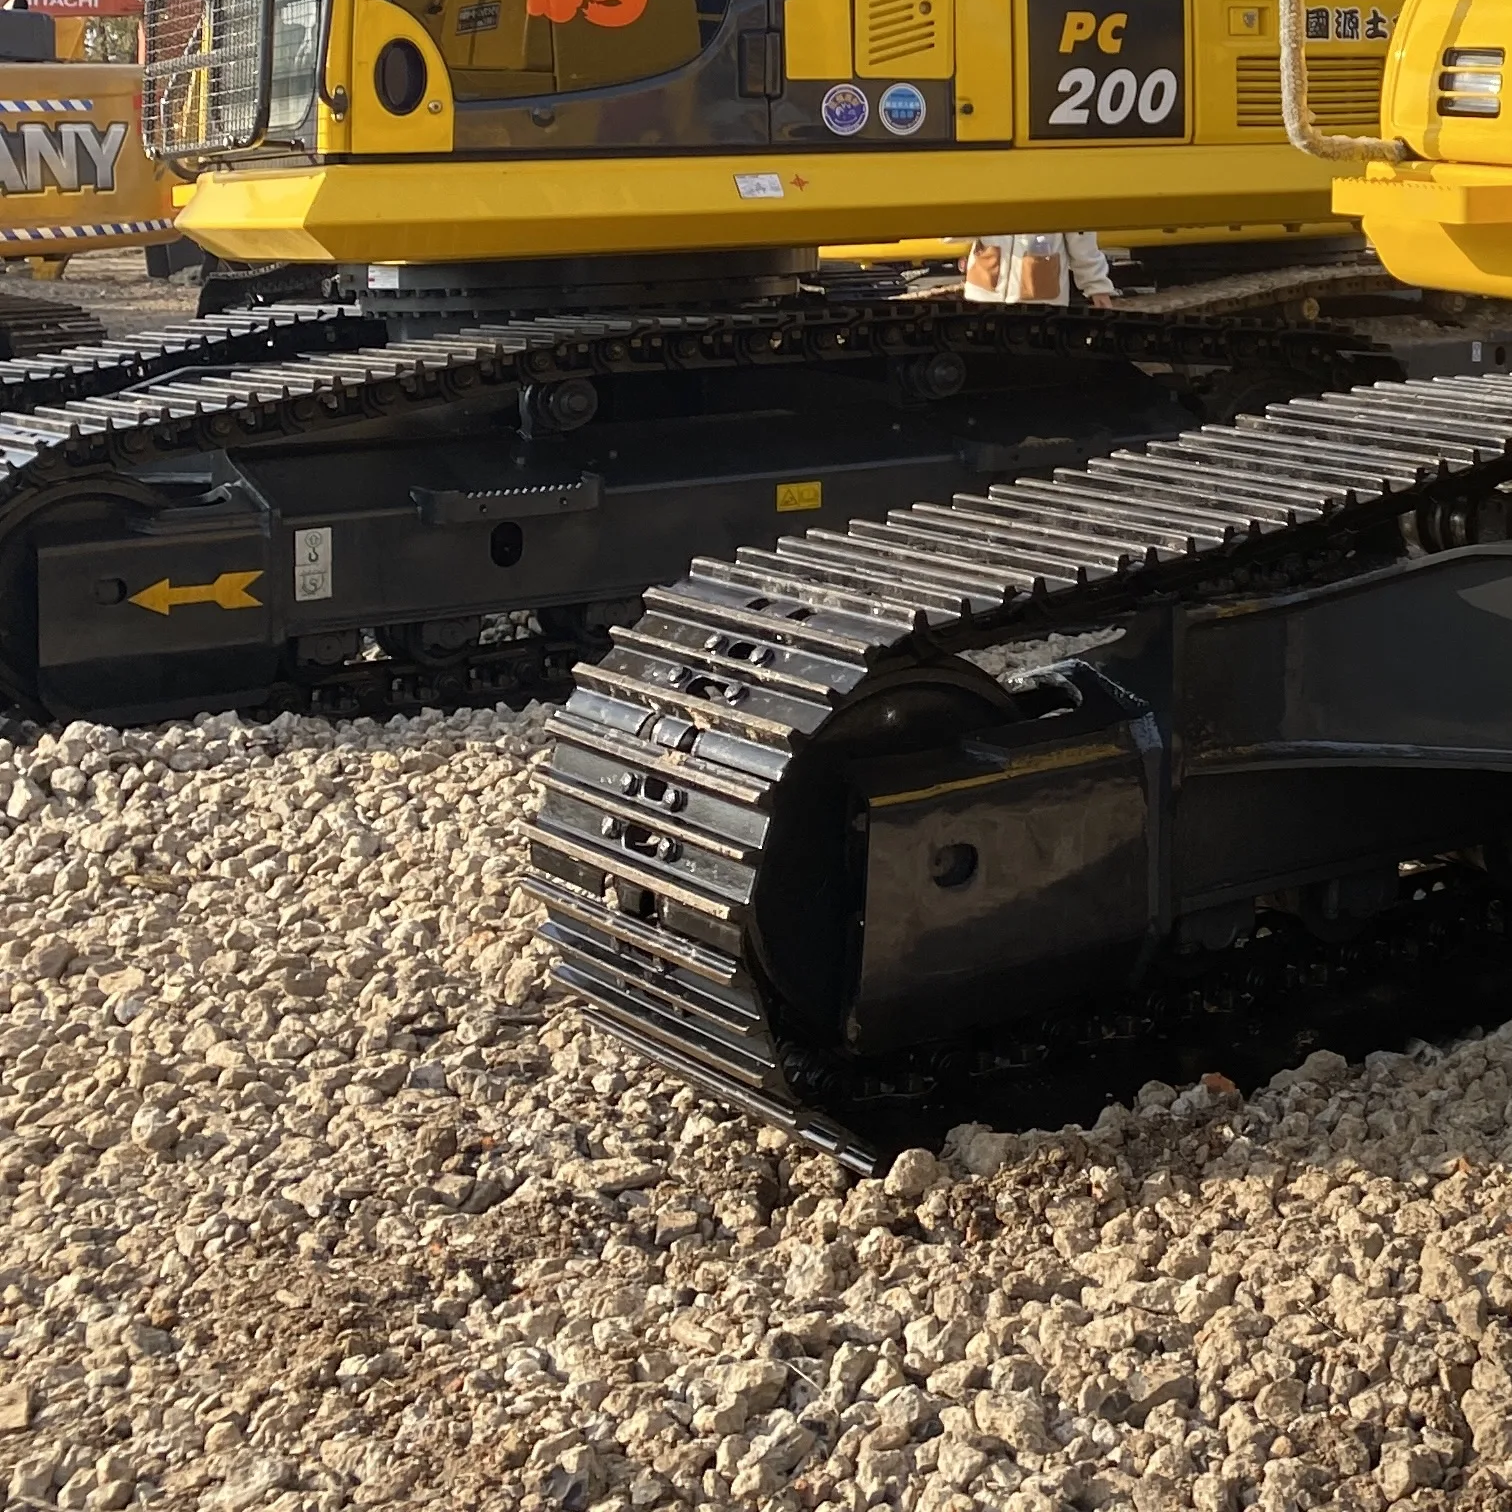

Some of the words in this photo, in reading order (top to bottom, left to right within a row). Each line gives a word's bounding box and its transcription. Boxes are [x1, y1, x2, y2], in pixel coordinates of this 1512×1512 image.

[1058, 11, 1128, 54] PC
[1305, 7, 1400, 41] 國源土
[1048, 67, 1178, 125] 200
